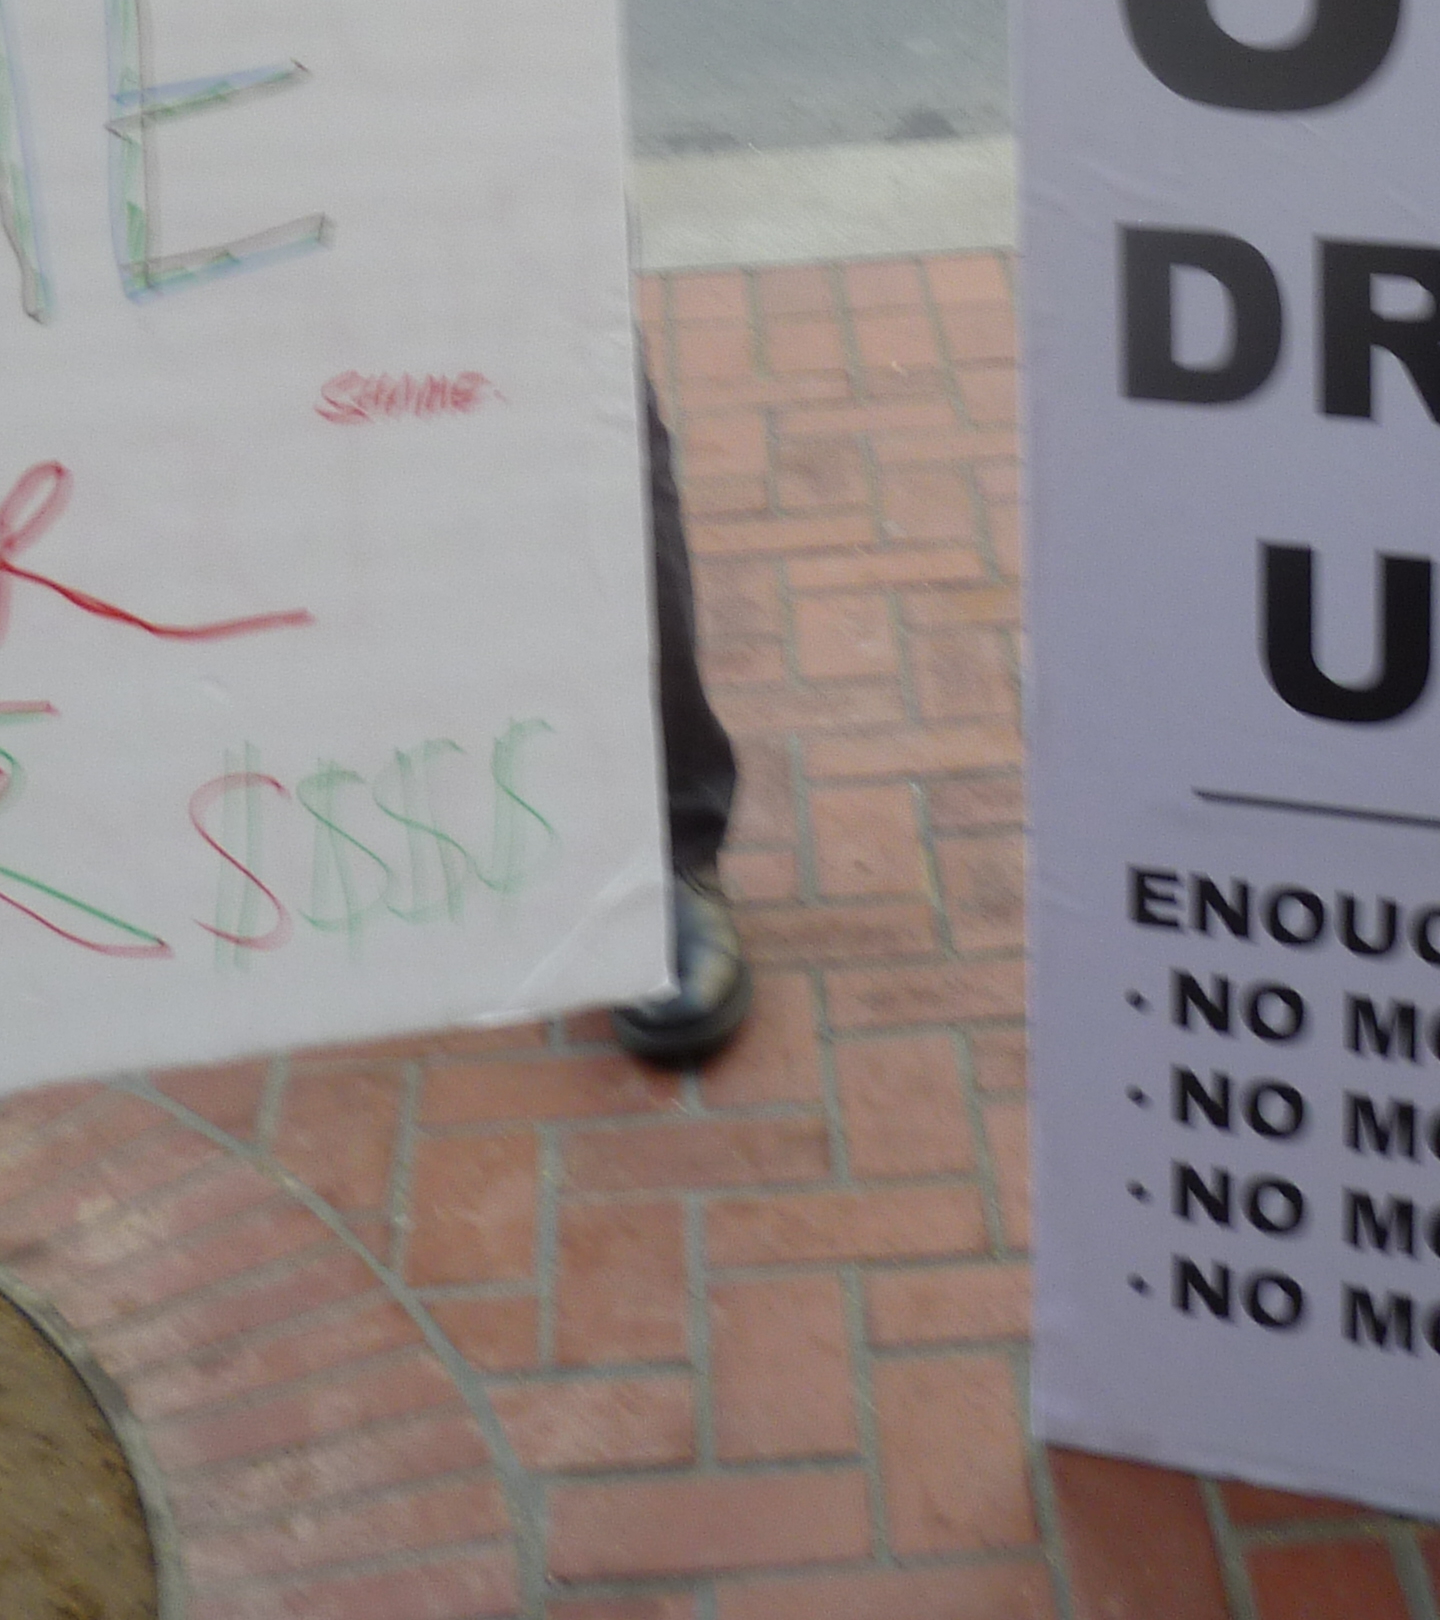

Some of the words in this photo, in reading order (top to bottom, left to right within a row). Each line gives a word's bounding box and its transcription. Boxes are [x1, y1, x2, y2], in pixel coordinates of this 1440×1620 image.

[1170, 968, 1311, 1048] NO
[1171, 1065, 1311, 1145] NO
[1171, 1160, 1311, 1241] NO
[1171, 1254, 1310, 1335] NO
